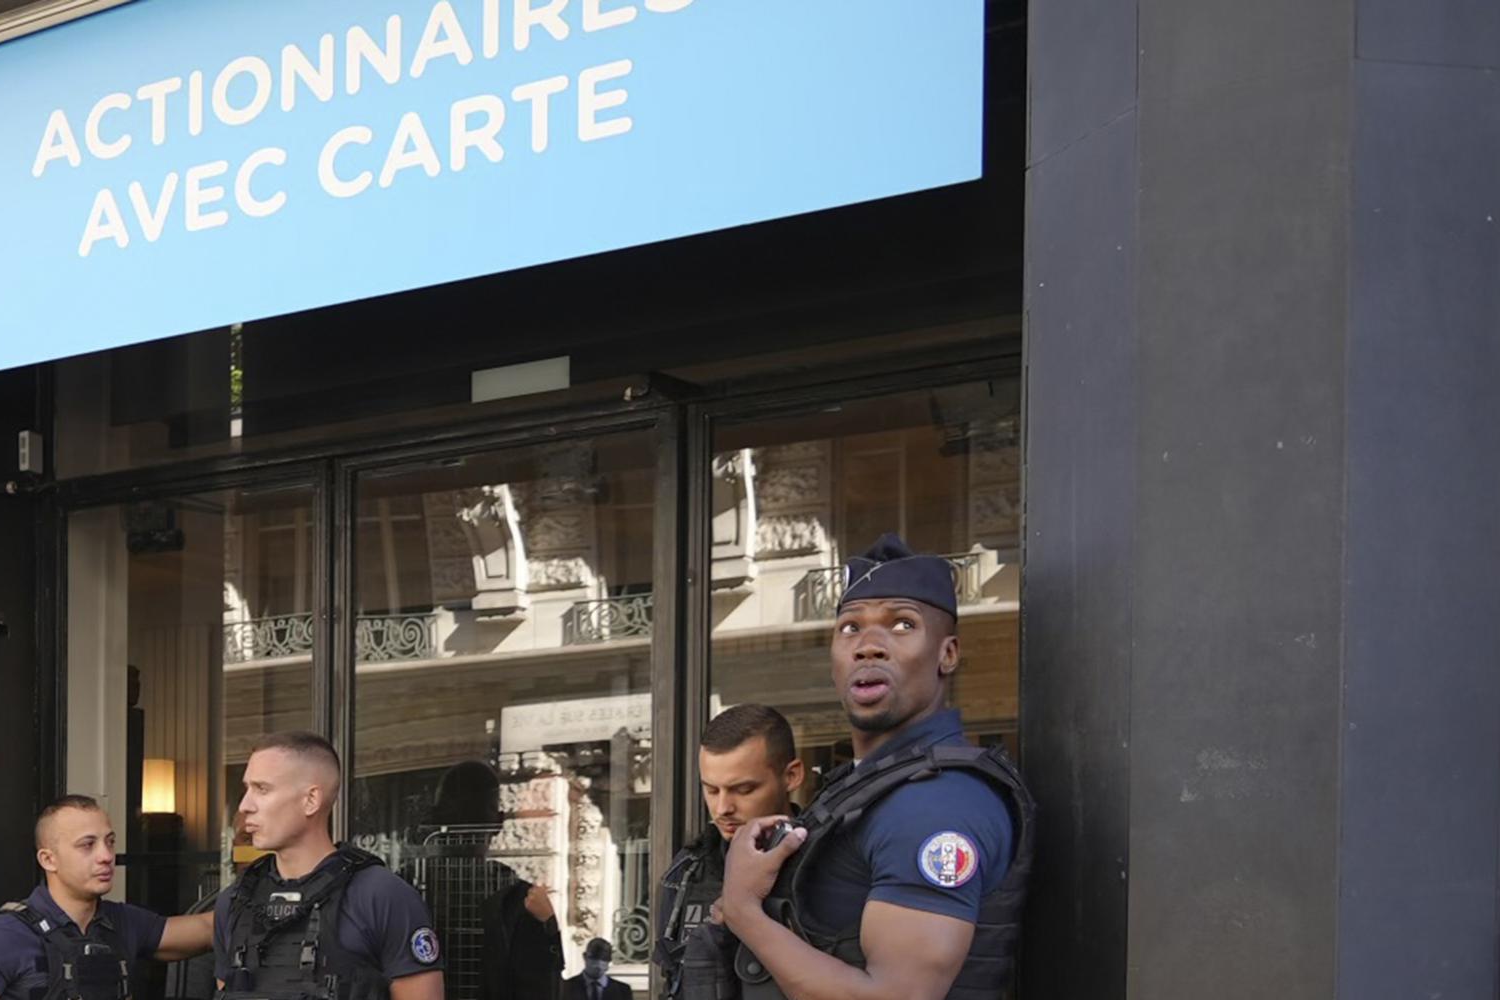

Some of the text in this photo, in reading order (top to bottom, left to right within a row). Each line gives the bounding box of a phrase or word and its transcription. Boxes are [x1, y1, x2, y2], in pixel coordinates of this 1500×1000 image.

[32, 0, 696, 177] ACTIONNAIR
[78, 59, 632, 257] AVEC CARTE
